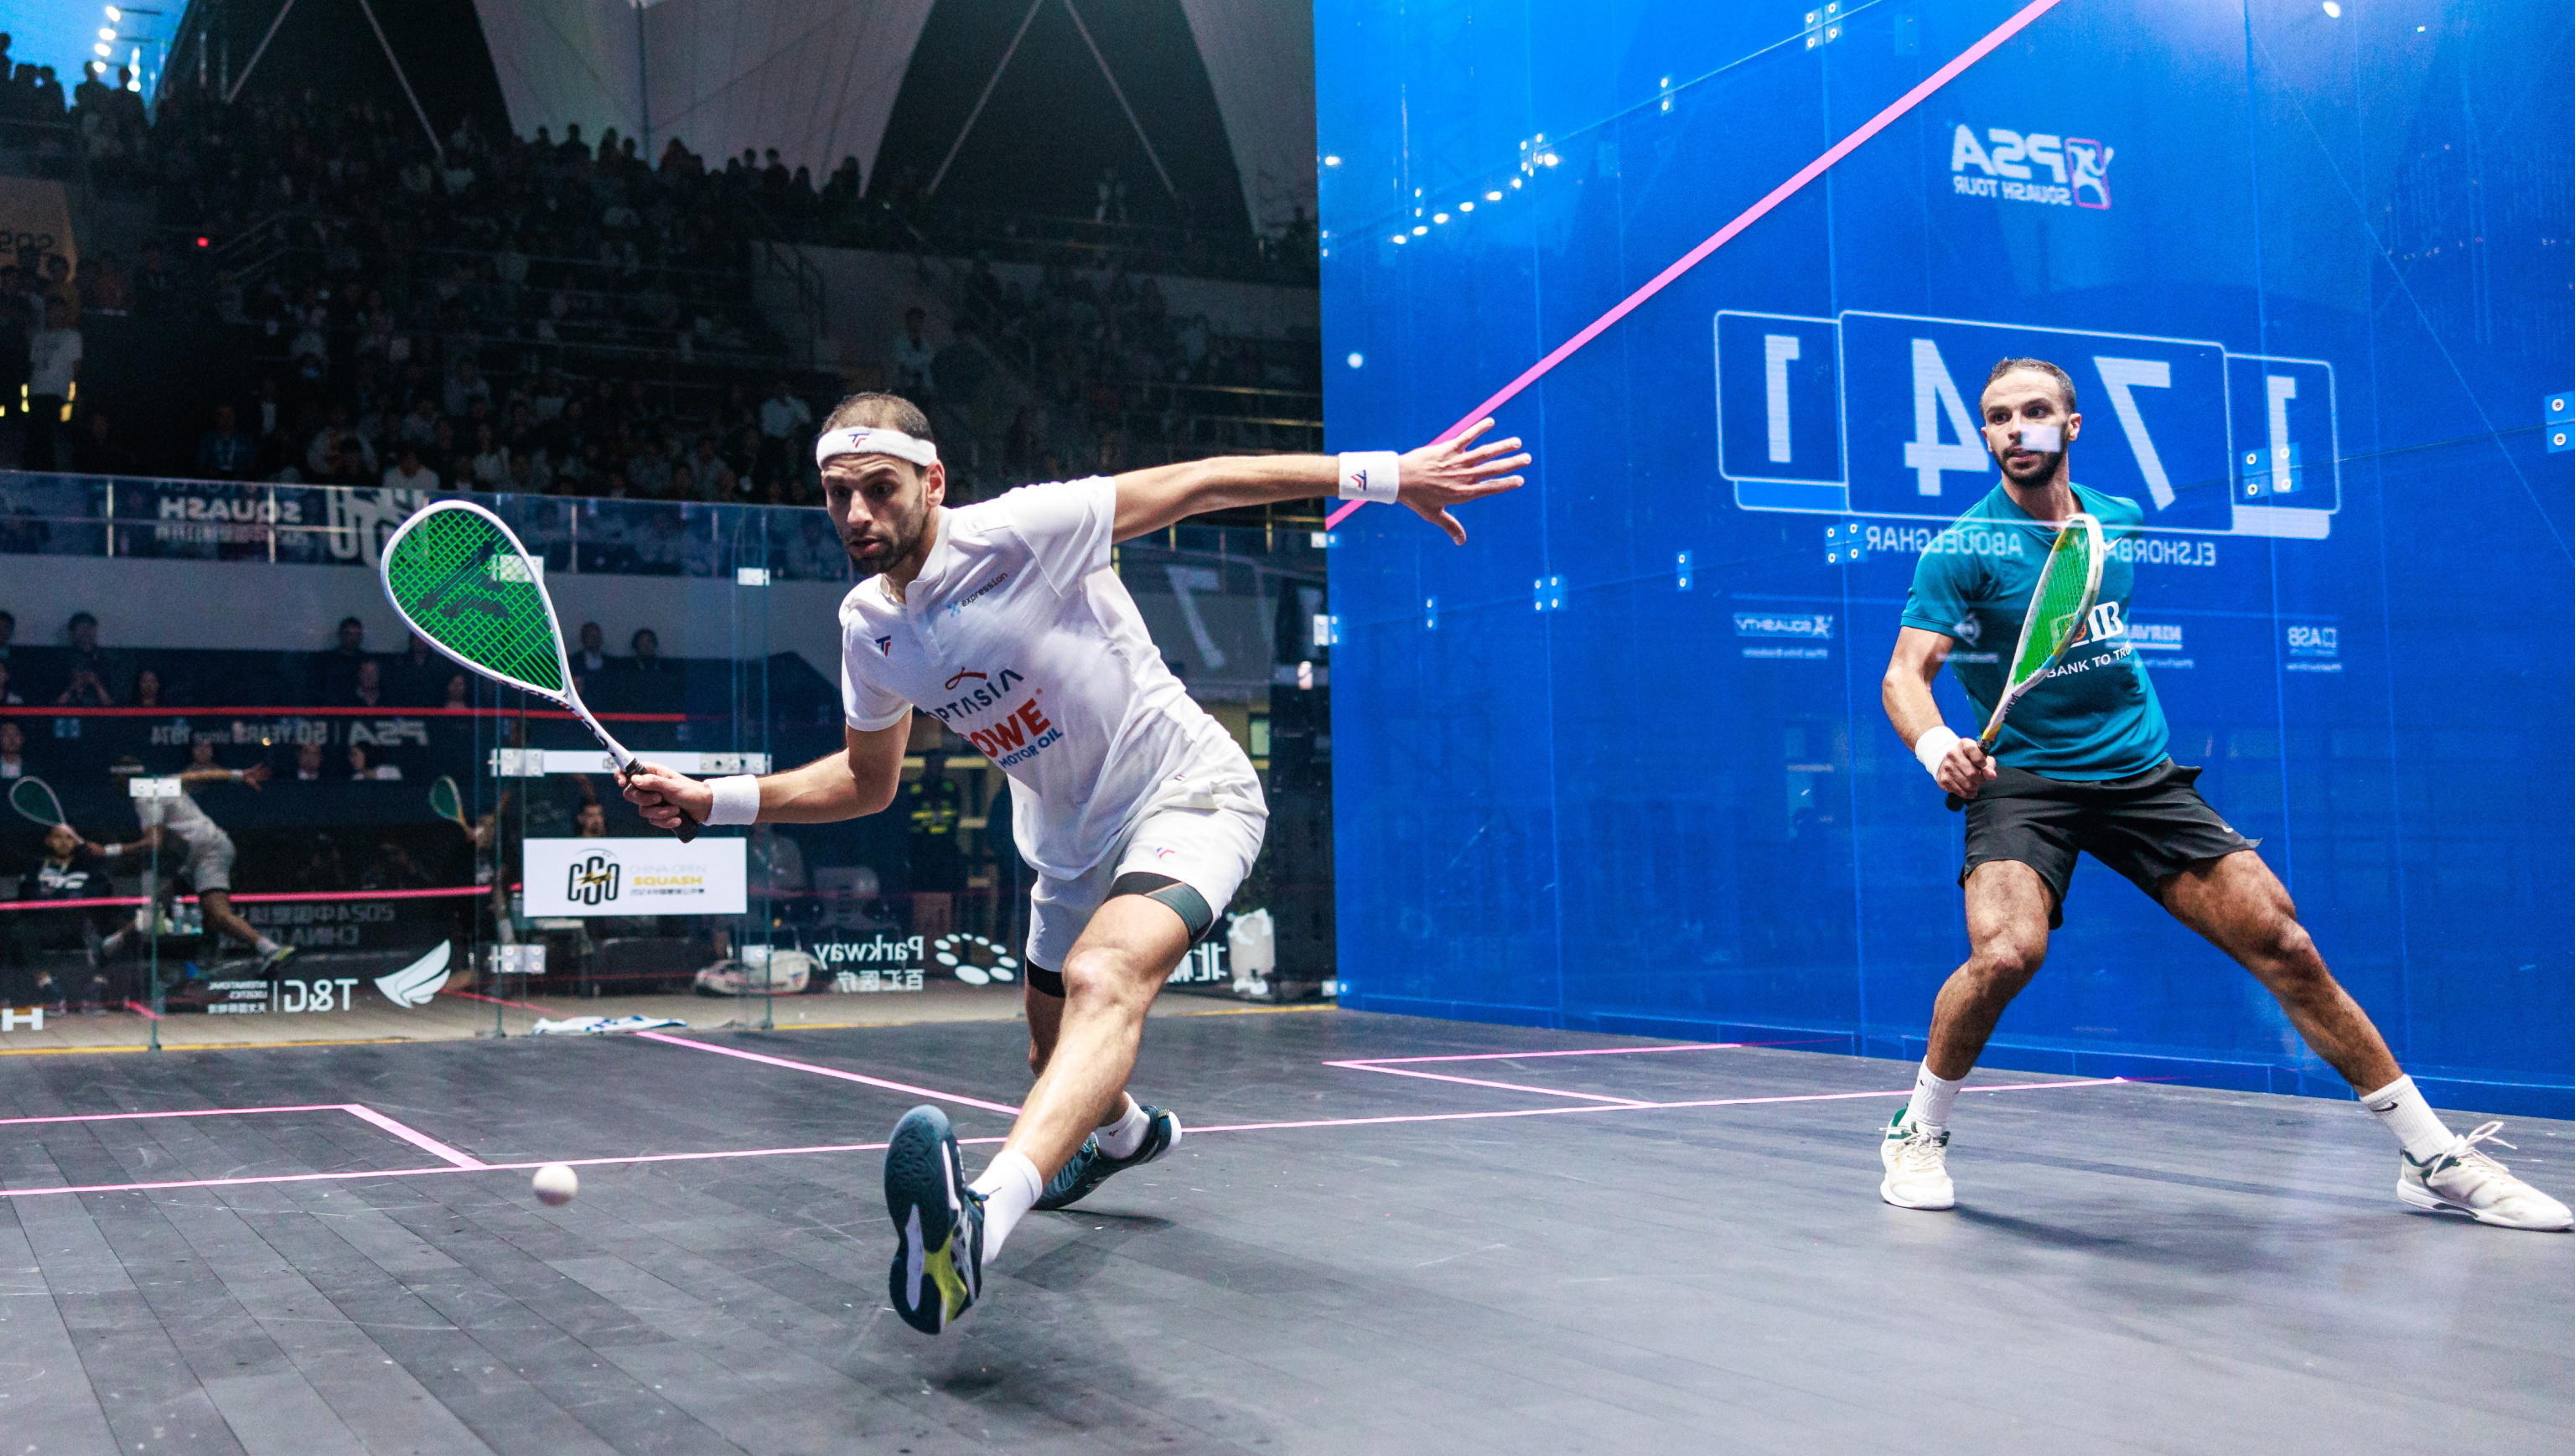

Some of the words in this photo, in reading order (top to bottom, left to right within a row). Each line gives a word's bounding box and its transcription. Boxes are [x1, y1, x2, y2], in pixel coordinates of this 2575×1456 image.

[961, 573, 1008, 607] expression
[2091, 655, 2111, 668] TO
[923, 668, 1024, 722] PTASIA
[957, 697, 1052, 759] OWE
[998, 744, 1039, 769] MOTOR
[1038, 727, 1064, 749] OIL
[633, 875, 702, 886] SQUASH
